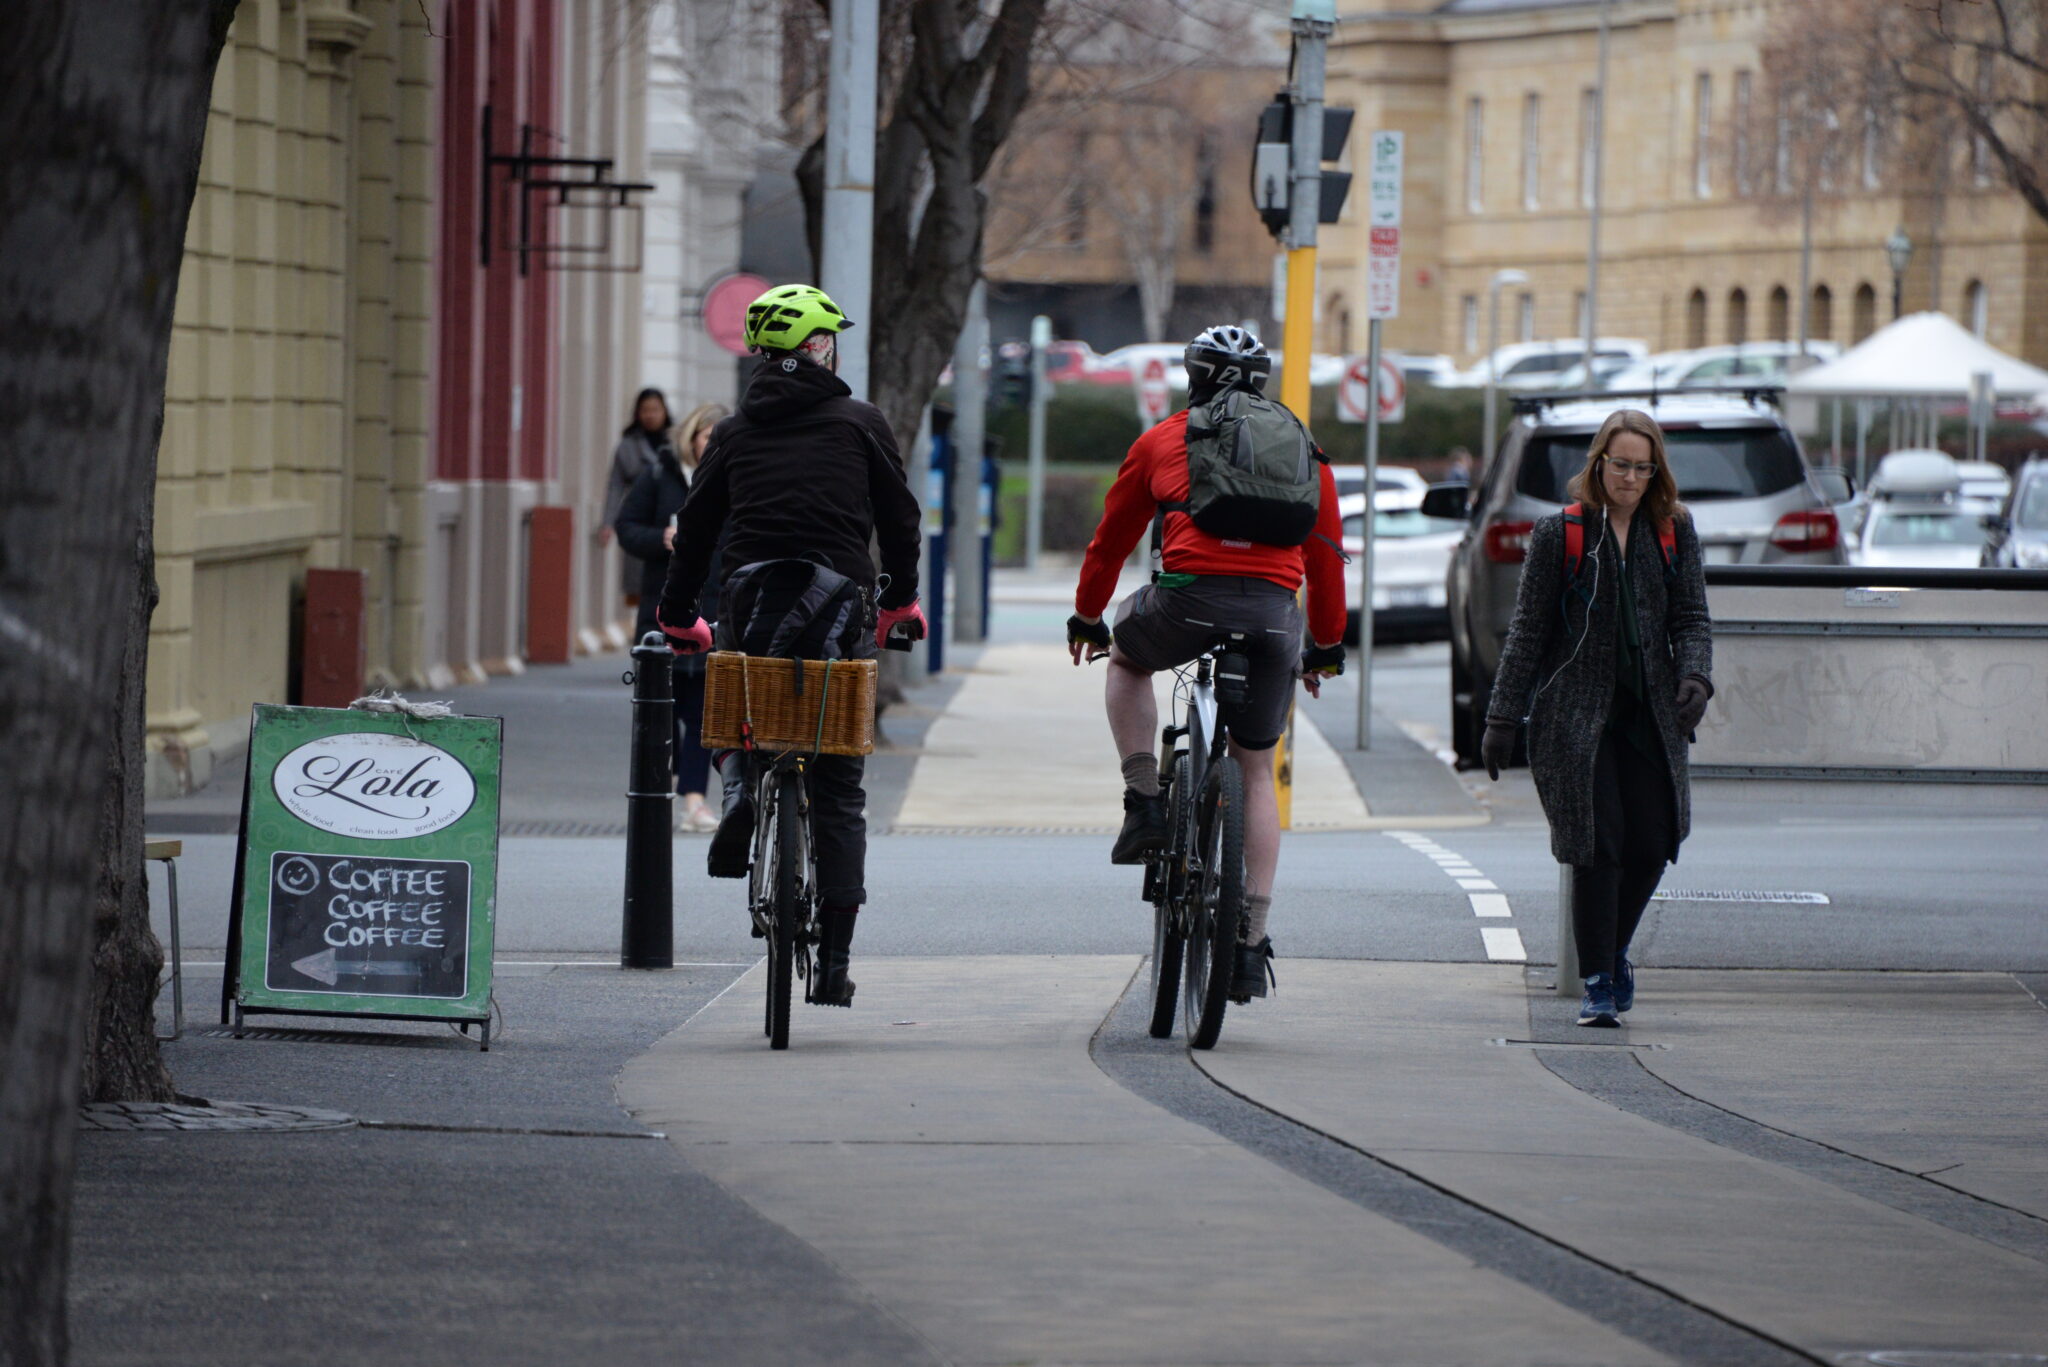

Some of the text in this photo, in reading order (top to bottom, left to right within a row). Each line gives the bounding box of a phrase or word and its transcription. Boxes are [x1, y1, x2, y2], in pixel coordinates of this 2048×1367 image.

[293, 755, 444, 820] Lola
[375, 767, 404, 775] CAFÉ
[288, 797, 457, 836] whole food clean food good food
[328, 859, 447, 896] COFFEE
[328, 894, 443, 925] COFFEE
[323, 921, 446, 949] COFFEE
